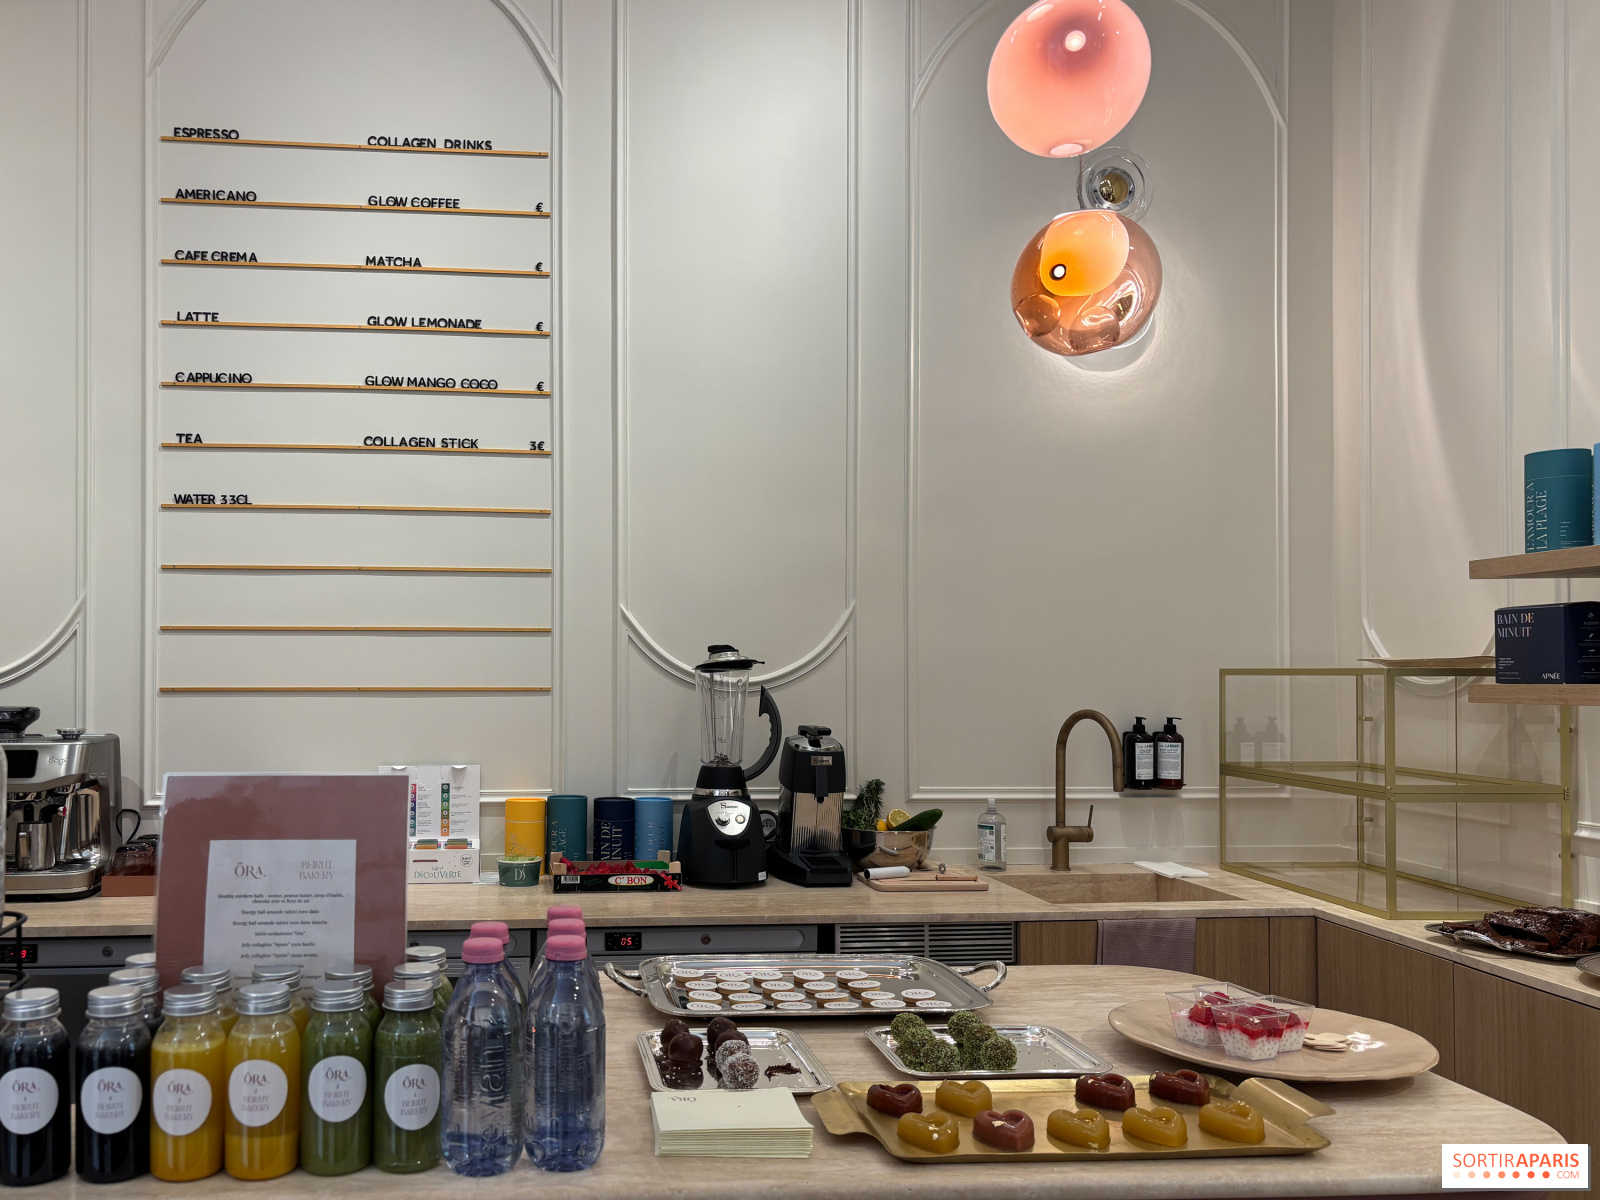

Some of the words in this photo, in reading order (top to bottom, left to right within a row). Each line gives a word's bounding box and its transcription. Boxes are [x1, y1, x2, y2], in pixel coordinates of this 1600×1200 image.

[173, 127, 240, 140] ESPRESSO
[367, 136, 436, 149] COLLAGEN
[444, 138, 493, 151] DRINKS
[175, 188, 257, 202] AMERICANO
[368, 196, 408, 208] GLOW
[410, 196, 460, 209] COFFEE
[536, 202, 544, 212] €
[174, 250, 208, 261] CAFE
[210, 250, 258, 263] CREMA
[365, 256, 422, 268] MATCHA
[536, 262, 543, 272] €
[176, 311, 220, 322] LATTE
[366, 316, 408, 328] GLOW
[411, 317, 482, 330] LEMONADE
[536, 322, 544, 332] €
[175, 372, 252, 384] CAPPUCINO
[364, 375, 405, 388] GLOW
[406, 376, 456, 388] MANGO
[460, 378, 498, 390] COCO
[536, 381, 544, 392] €
[176, 433, 203, 444] TEA
[363, 436, 436, 448] COLLAGEN
[441, 438, 479, 449] STICK
[529, 440, 545, 451] 3€
[174, 494, 216, 505] WATER
[1536, 490, 1548, 530] PLAGE
[1536, 534, 1548, 550] LA
[1497, 613, 1518, 624] BAIN
[1520, 612, 1535, 624] DE
[1498, 626, 1532, 638] MINUIT
[1541, 672, 1560, 680] APNÉE
[601, 822, 611, 839] DE
[612, 826, 622, 860] INUIT
[601, 840, 610, 860] AIN
[301, 860, 333, 869] BEIRUT
[299, 871, 334, 879] BAKERY
[514, 868, 526, 880] DS
[627, 877, 647, 885] BON
